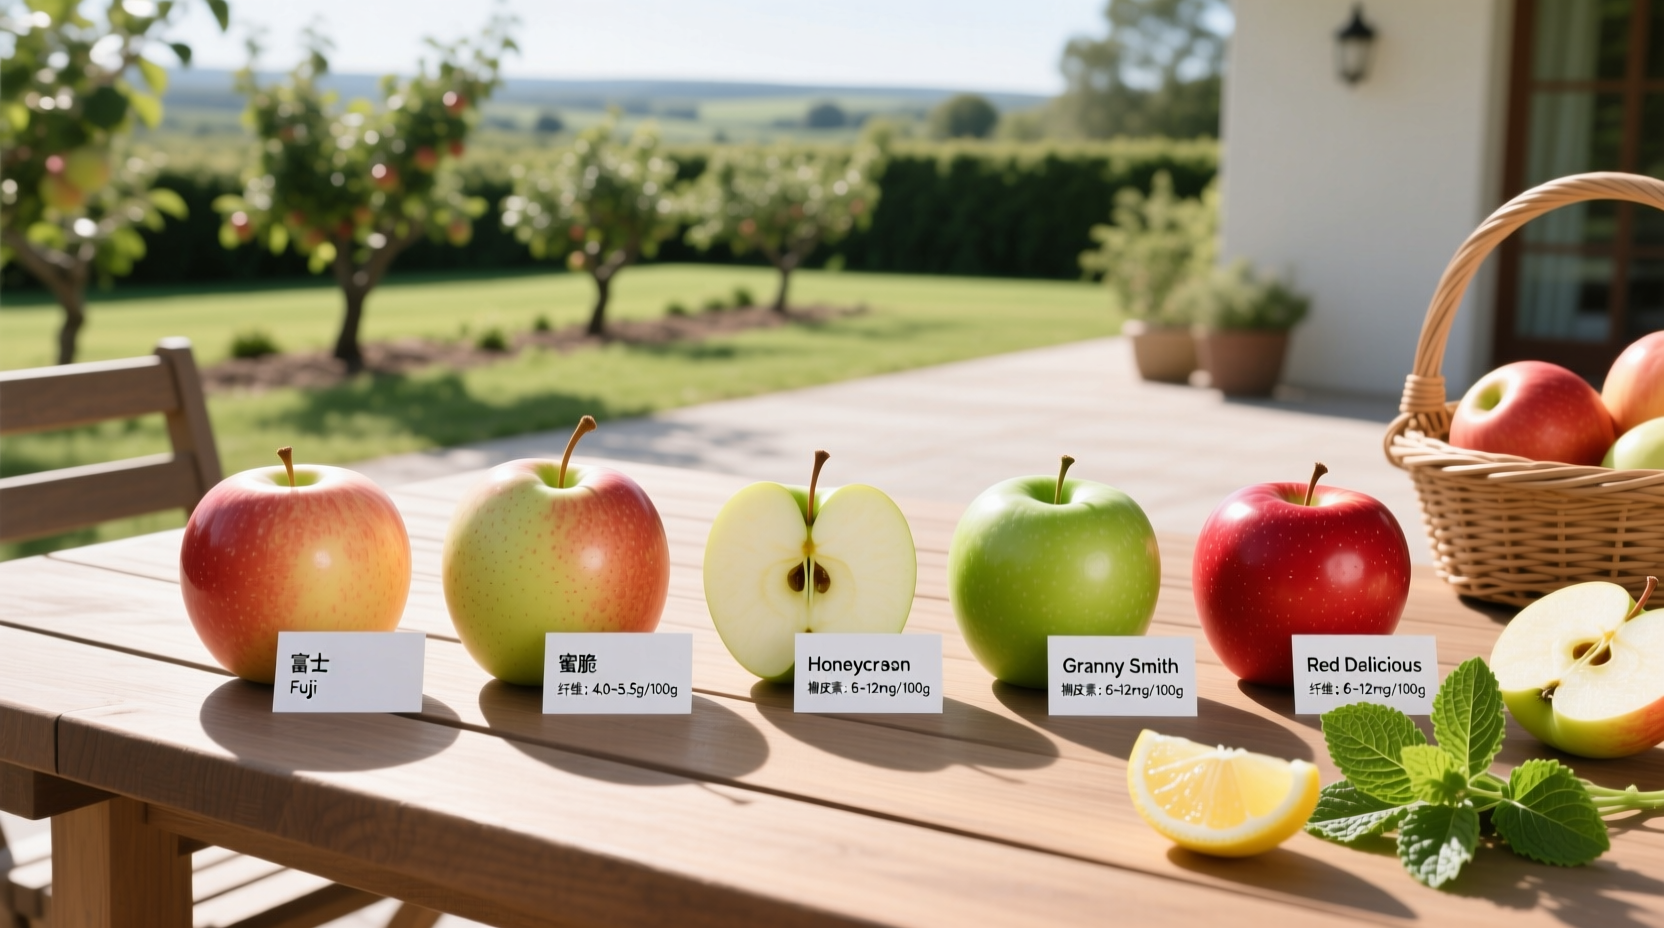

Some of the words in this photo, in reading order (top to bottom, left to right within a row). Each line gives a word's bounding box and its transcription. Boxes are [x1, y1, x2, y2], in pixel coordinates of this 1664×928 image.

[291, 653, 330, 674] 富士
[559, 653, 598, 674] 蜜脆
[1062, 657, 1125, 679] Granny
[1129, 657, 1179, 674] Smith
[1307, 656, 1340, 673] Red
[290, 680, 318, 700] Fuji
